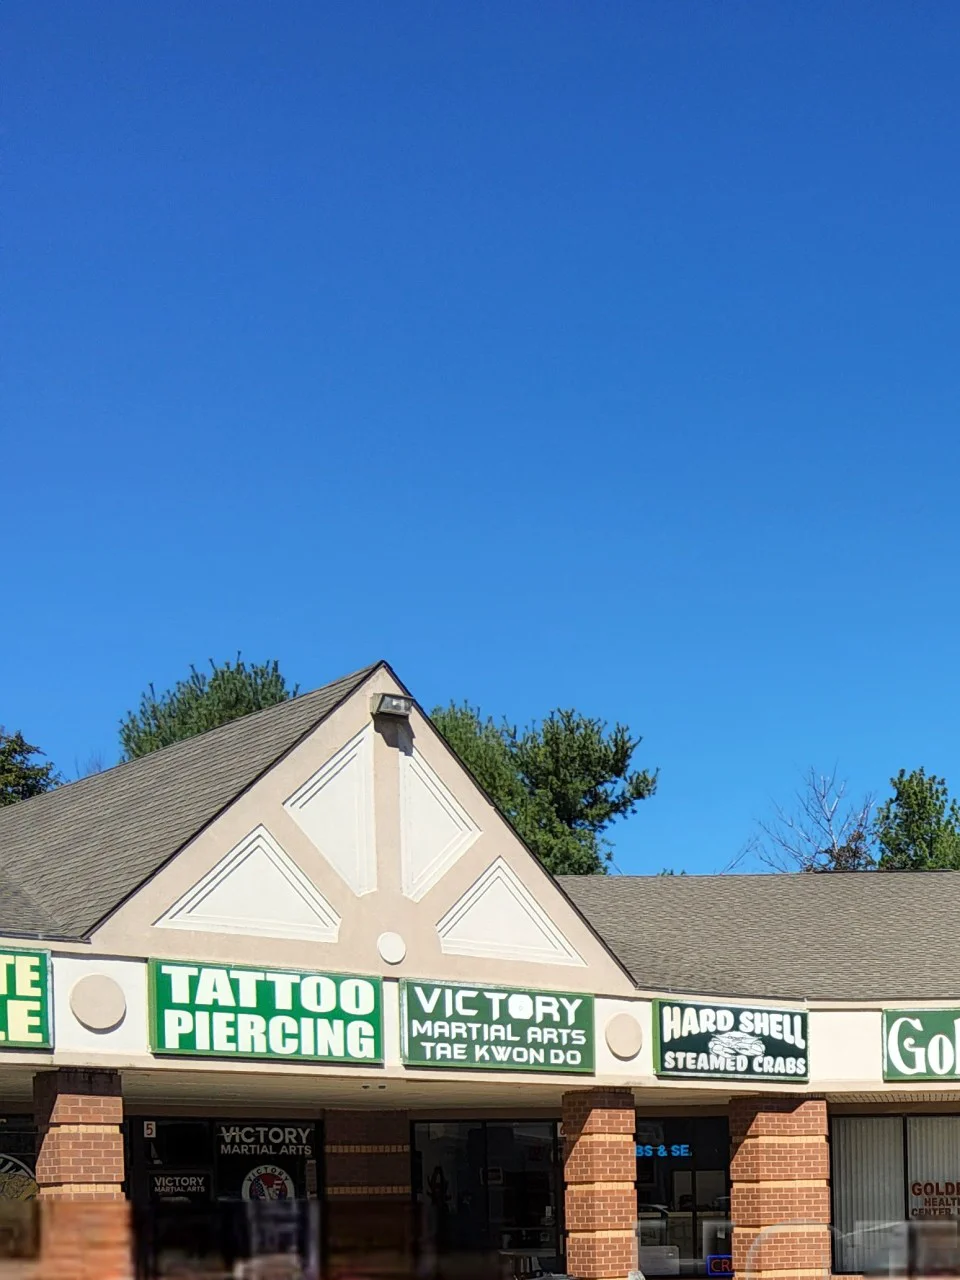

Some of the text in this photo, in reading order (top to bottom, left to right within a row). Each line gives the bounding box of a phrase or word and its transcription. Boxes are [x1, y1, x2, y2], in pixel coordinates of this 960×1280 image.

[161, 964, 376, 1016] TATTOO
[163, 1008, 376, 1060] PIERCING
[411, 1018, 587, 1047] MARTIAL ARTS
[662, 1005, 806, 1050] HARD SHELL
[420, 1040, 583, 1066] TAE KWON DO
[664, 1050, 806, 1075] STEAMED CRABS
[146, 1122, 154, 1136] 5
[221, 1126, 311, 1144] VICTORY
[220, 1144, 312, 1155] MARTIAL ARTS
[657, 1144, 668, 1157] &
[671, 1144, 693, 1157] SE
[154, 1176, 205, 1186] VICTORY
[246, 1166, 290, 1183] VICTORY
[154, 1185, 206, 1193] MARTIAL ARTS
[711, 1258, 732, 1272] CR
